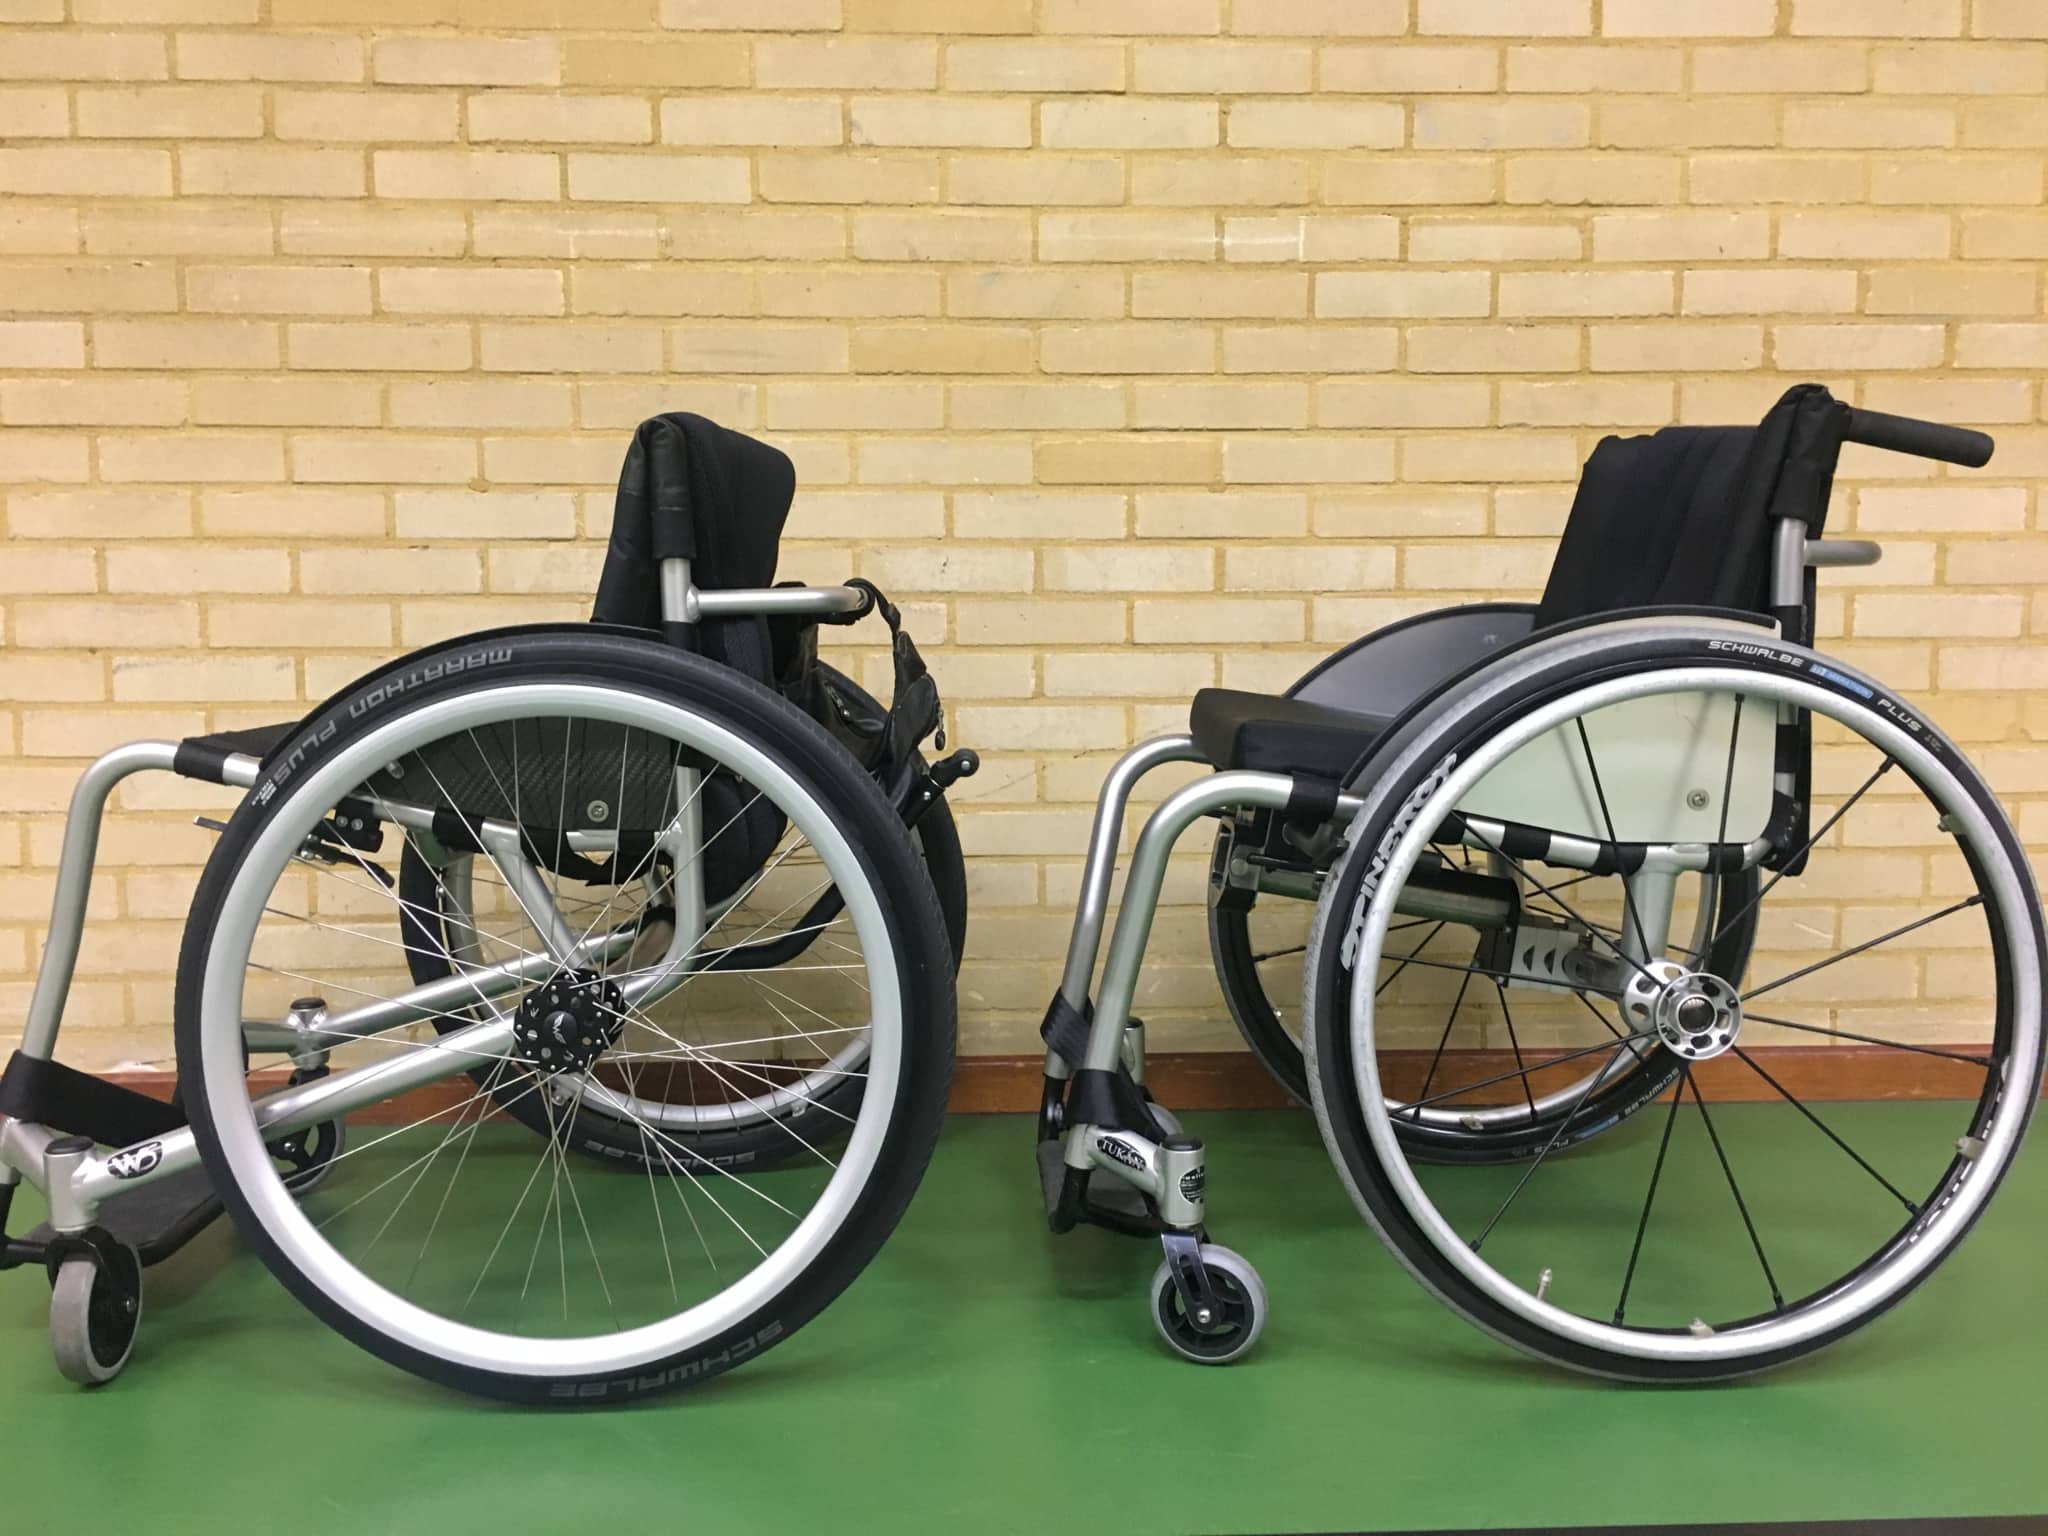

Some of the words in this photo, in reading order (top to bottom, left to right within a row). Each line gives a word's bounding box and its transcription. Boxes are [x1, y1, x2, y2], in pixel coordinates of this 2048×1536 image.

[350, 649, 513, 719] MARATHON
[1708, 640, 1804, 668] SCHWALBE
[1877, 698, 1922, 732] PLUS
[273, 719, 338, 785] PLUS
[551, 1319, 784, 1398] SCHWALBE
